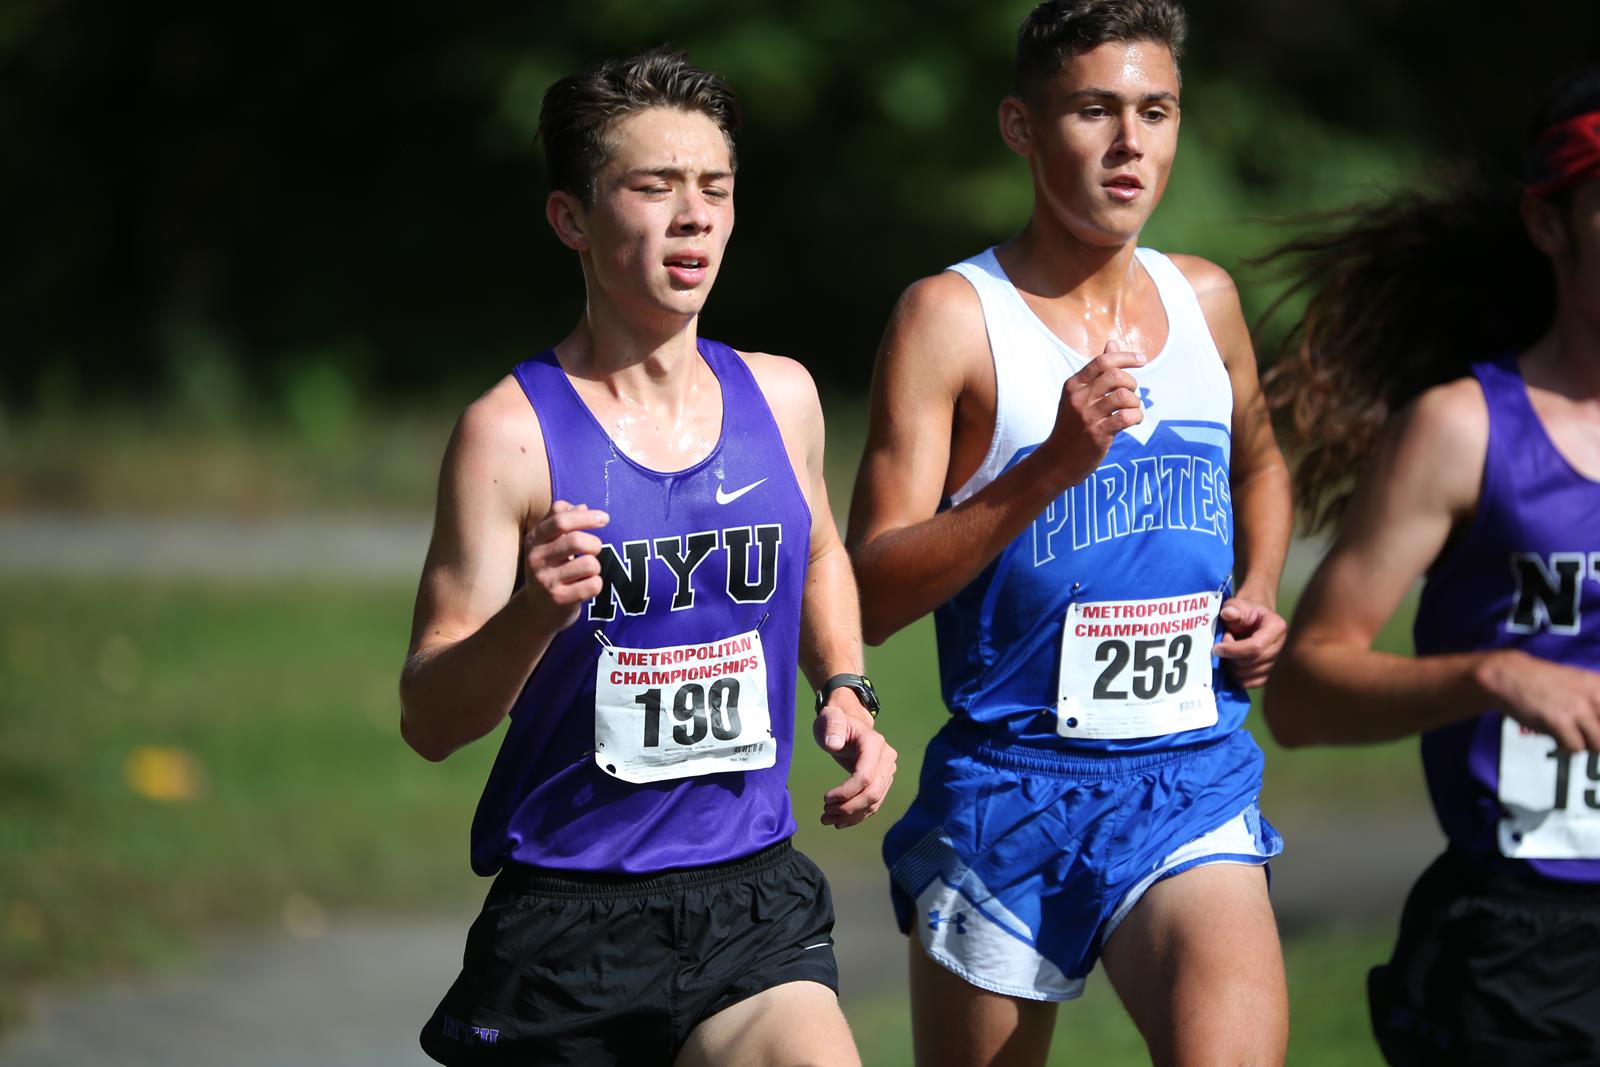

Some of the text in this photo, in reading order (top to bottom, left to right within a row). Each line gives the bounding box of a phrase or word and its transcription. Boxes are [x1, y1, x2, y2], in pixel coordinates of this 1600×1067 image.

[1033, 455, 1231, 567] PIRATES
[588, 523, 782, 622] NYU
[1505, 552, 1600, 636] N
[1075, 613, 1210, 638] CHAMPIONSHIPS
[1082, 596, 1210, 620] METROPOLITAN
[610, 655, 759, 685] CHAMPIONSHIPS
[618, 636, 752, 666] METROPOLITAN
[1092, 634, 1193, 700] 253
[635, 677, 742, 748] 190
